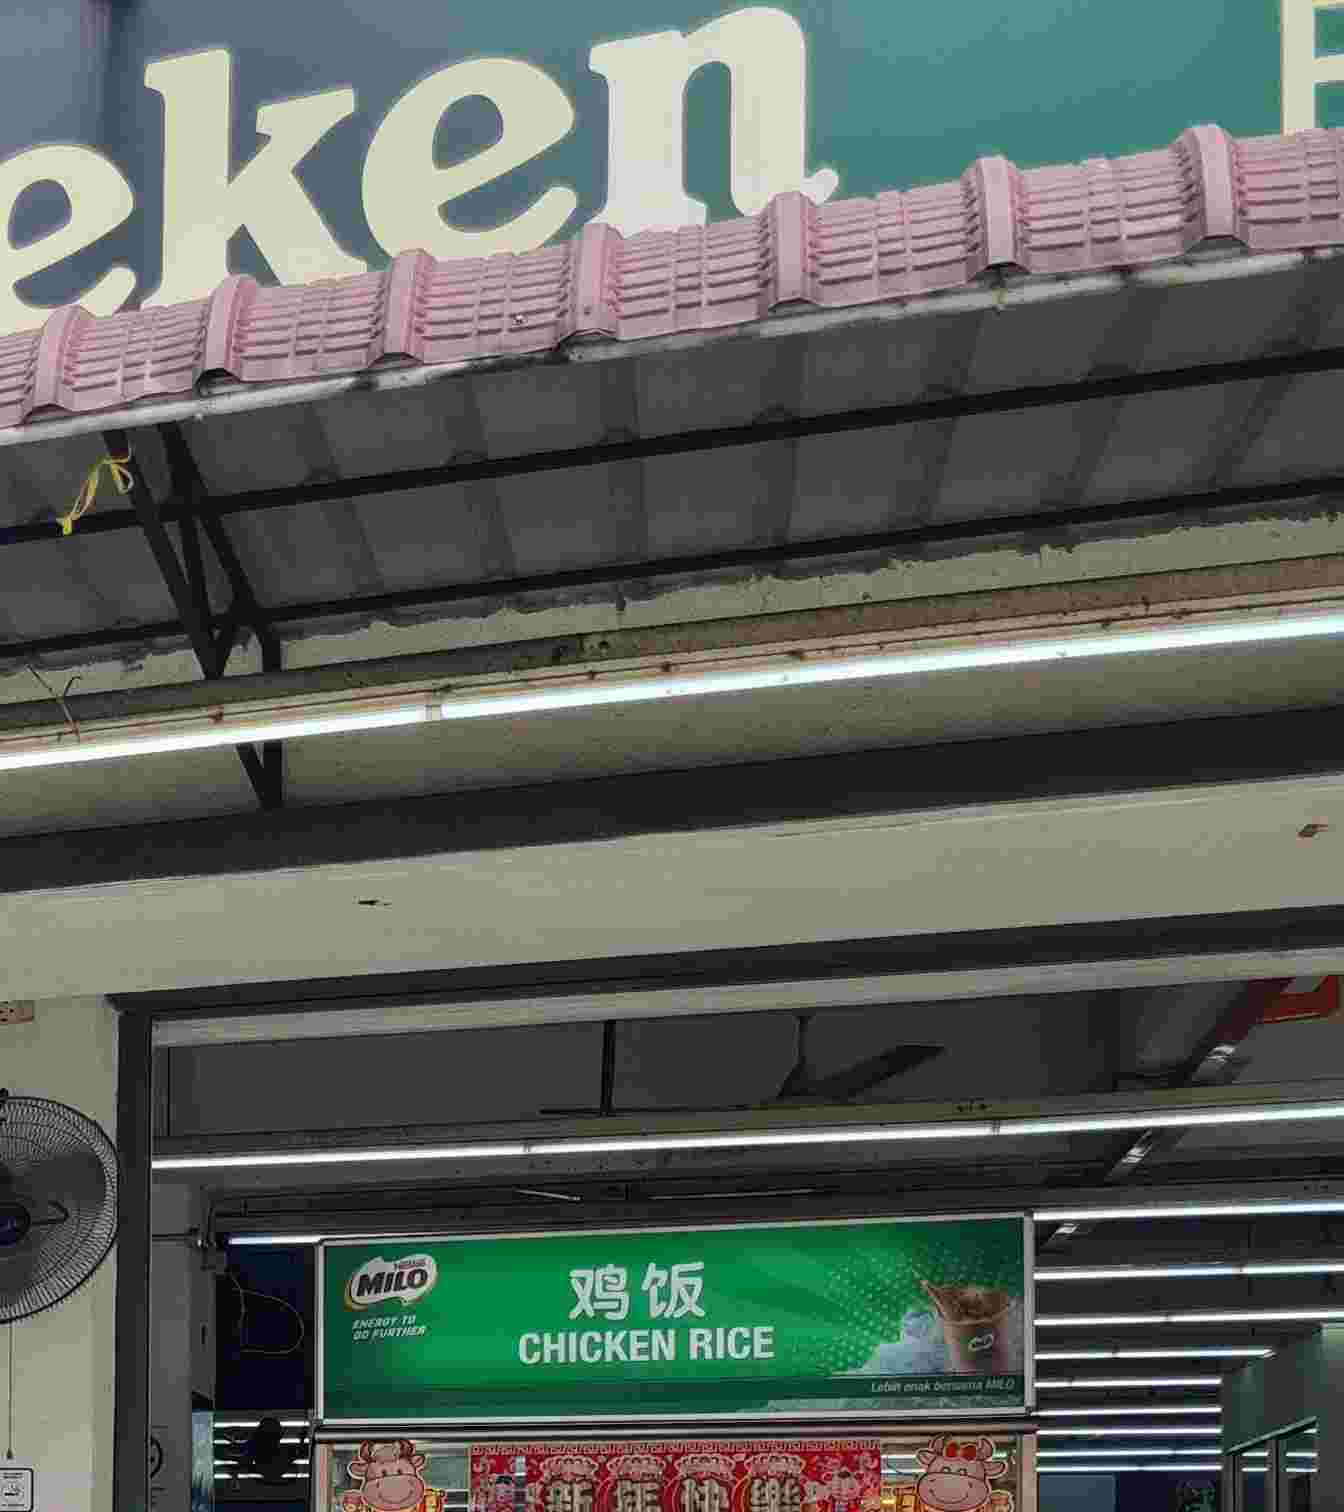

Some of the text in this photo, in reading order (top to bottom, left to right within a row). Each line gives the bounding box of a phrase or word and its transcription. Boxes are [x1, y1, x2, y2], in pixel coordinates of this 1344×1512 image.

[357, 1269, 428, 1297] MILO
[569, 1262, 705, 1320] 鸡饭
[352, 1314, 416, 1329] ENERGY TO
[372, 1325, 427, 1339] FURTHER
[518, 1326, 775, 1365] CHICKEN RICE
